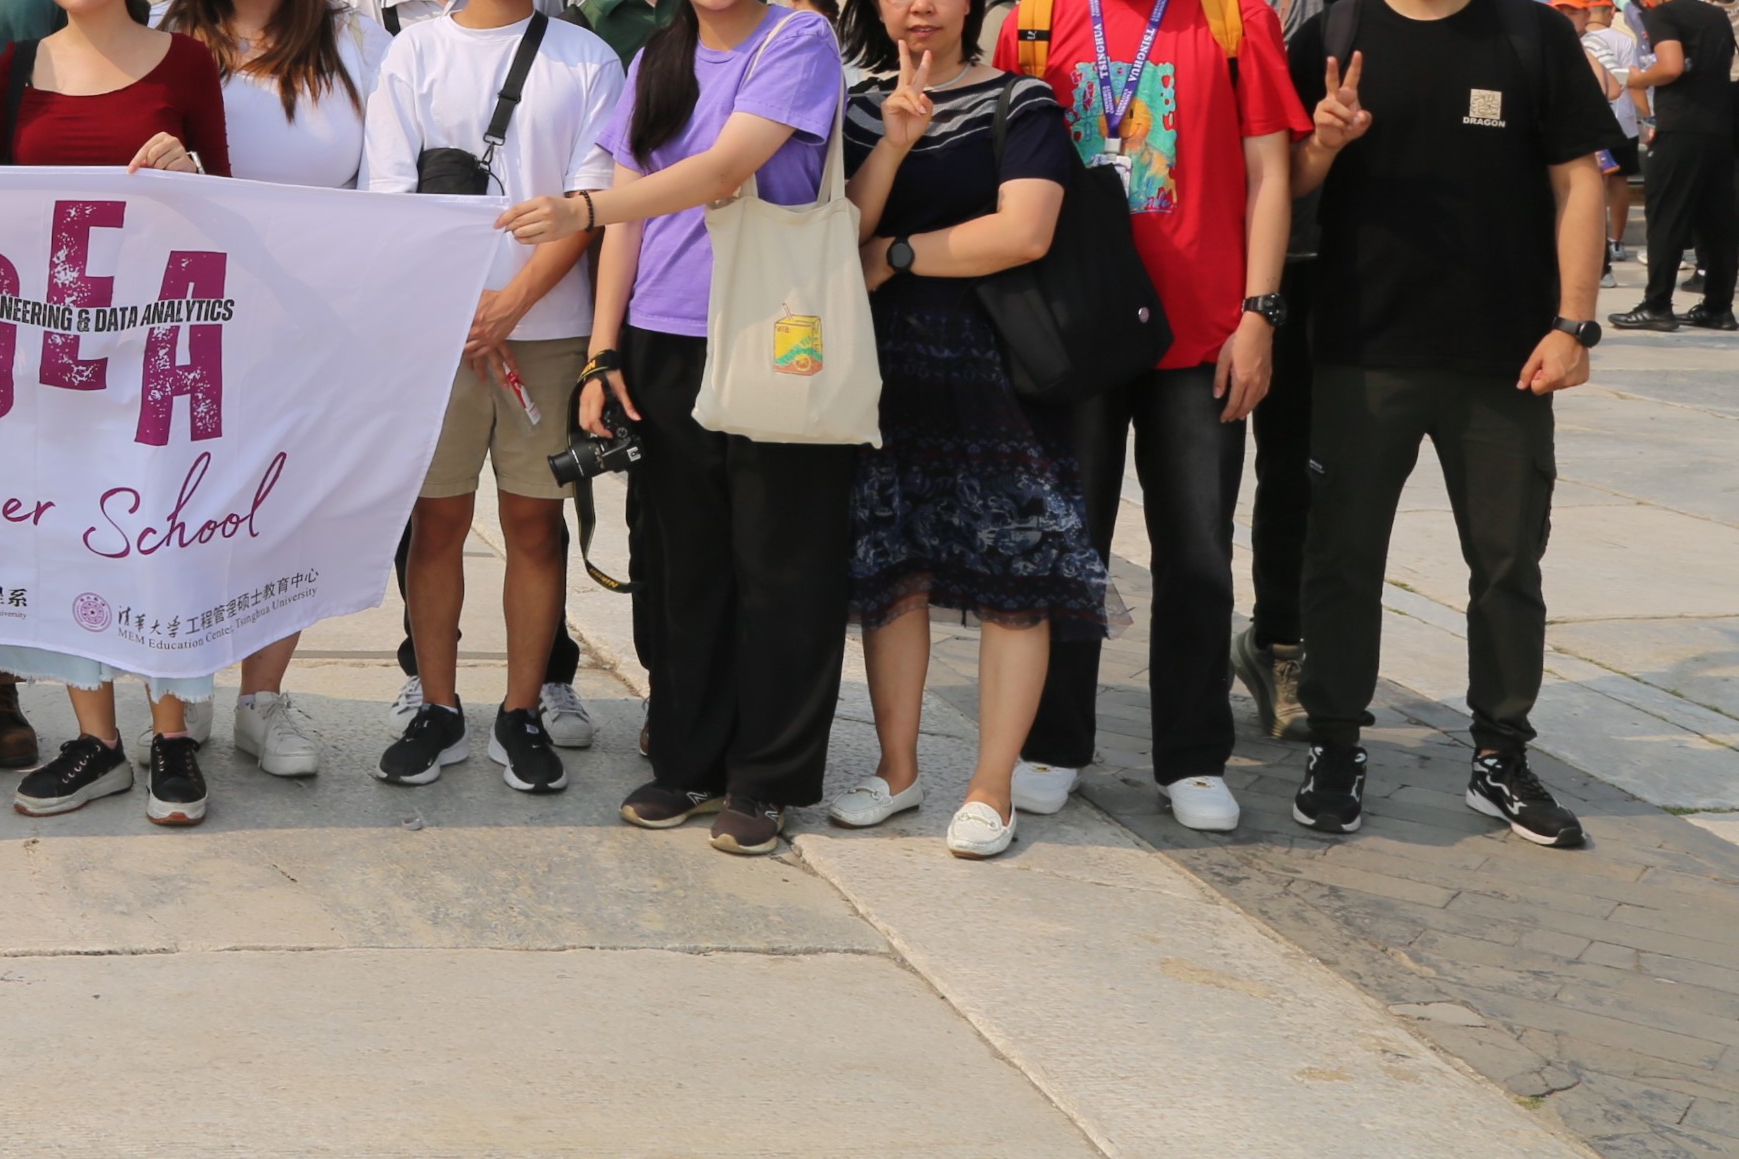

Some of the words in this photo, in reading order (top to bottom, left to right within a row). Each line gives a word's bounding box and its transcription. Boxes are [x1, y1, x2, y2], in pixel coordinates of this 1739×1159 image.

[1093, 23, 1109, 79] TSINGHUA
[1127, 27, 1156, 82] TSINGHUA
[1462, 116, 1506, 128] DRAGON
[76, 307, 91, 333] &
[94, 304, 139, 333] DATA
[140, 298, 235, 327] ANALYTICS
[82, 451, 287, 559] School
[118, 627, 145, 646] MEM
[148, 637, 204, 651] Education
[234, 606, 271, 629] Tsinghua
[272, 587, 318, 610] University
